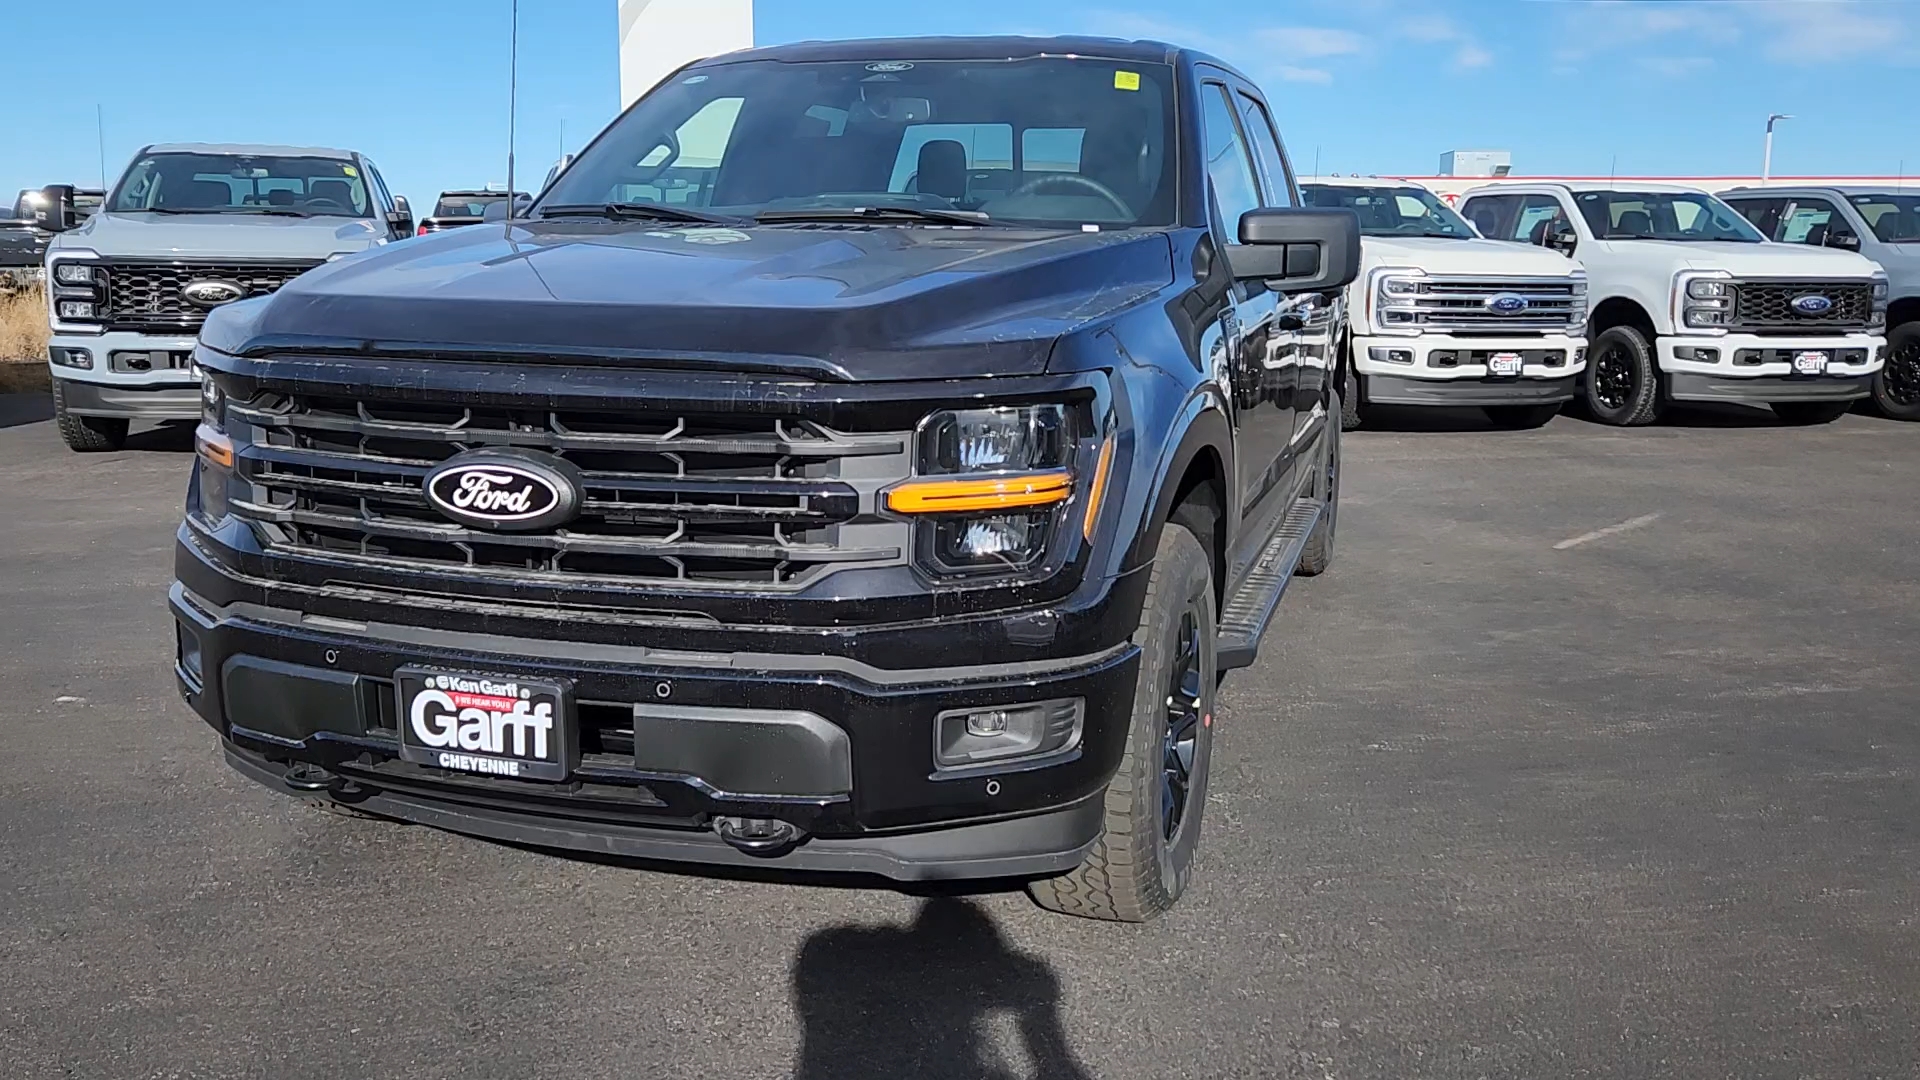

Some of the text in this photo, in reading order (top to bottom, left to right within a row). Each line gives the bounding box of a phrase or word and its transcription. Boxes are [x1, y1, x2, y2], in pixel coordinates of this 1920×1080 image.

[199, 287, 230, 300] Ford
[1489, 356, 1522, 371] Garff
[1794, 355, 1828, 370] Garff
[452, 471, 533, 512] Ford
[448, 676, 519, 698] Ken Garff
[411, 689, 553, 759] Garff
[439, 753, 519, 776] CHEYENNE
